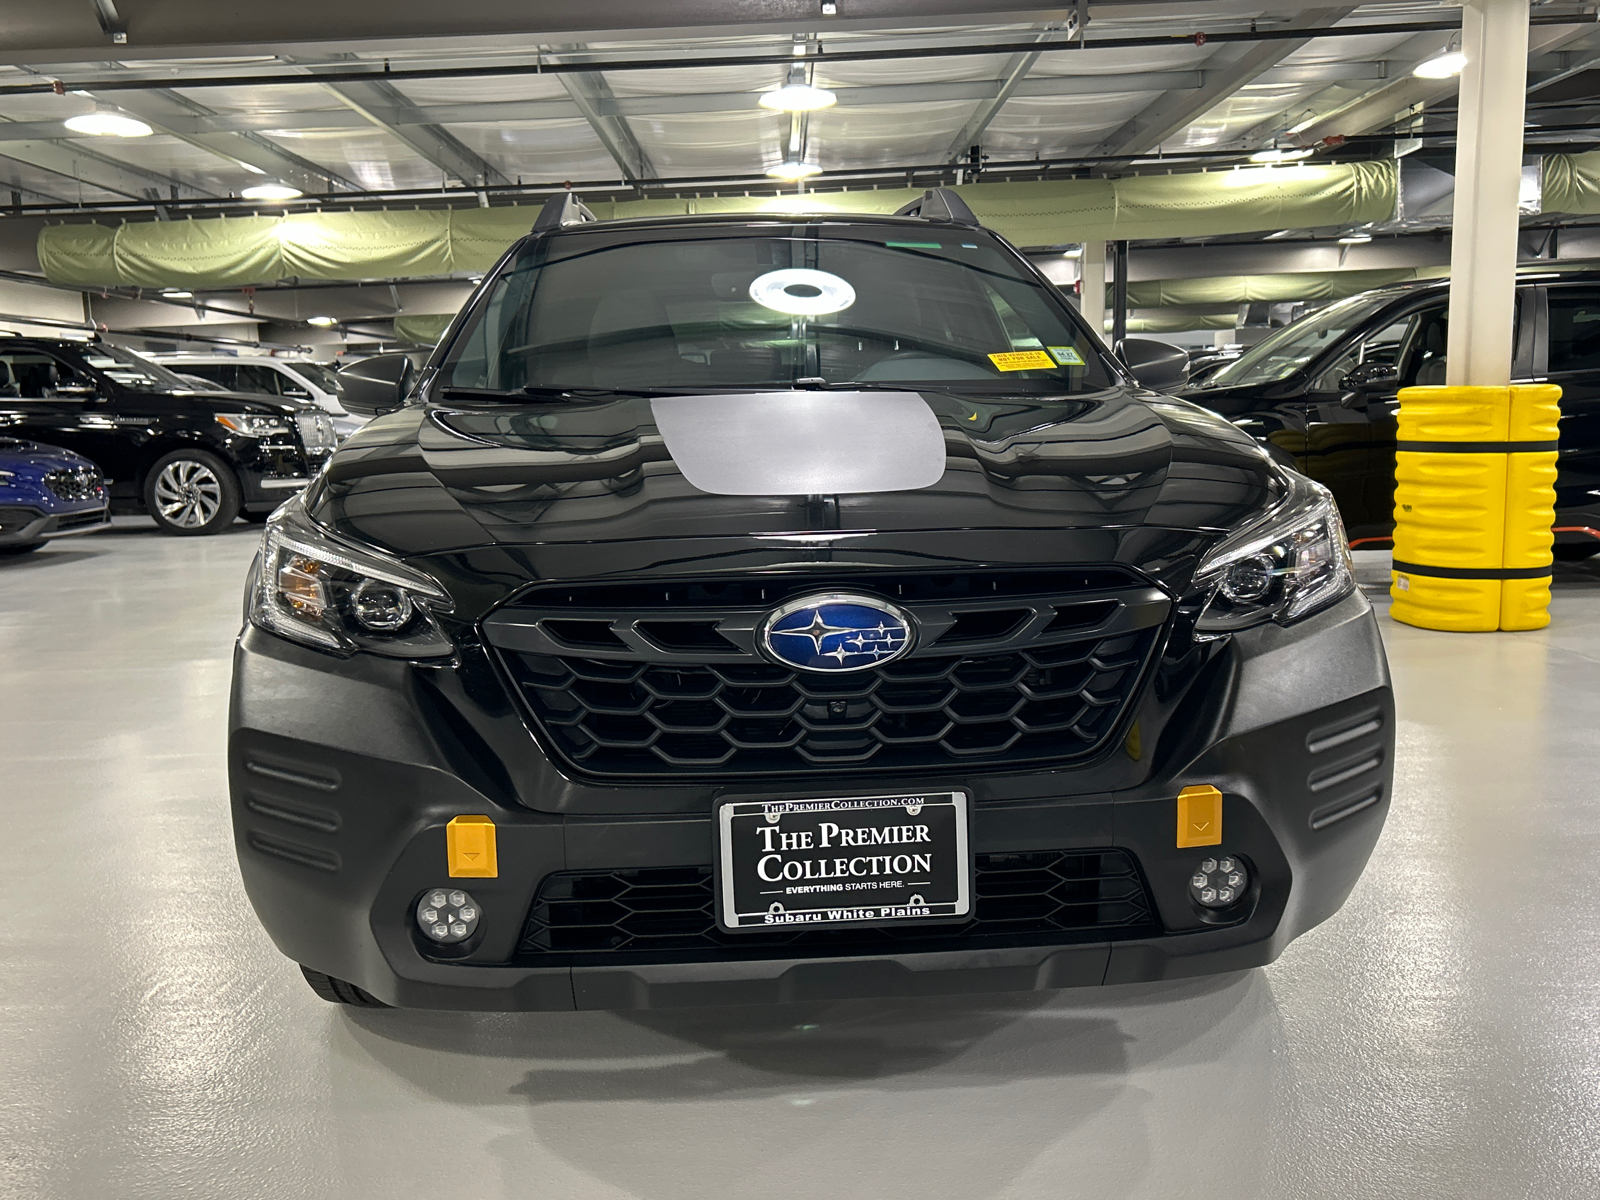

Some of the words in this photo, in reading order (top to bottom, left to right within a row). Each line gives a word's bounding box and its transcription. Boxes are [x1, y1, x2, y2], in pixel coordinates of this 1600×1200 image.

[756, 825, 814, 852] THE
[818, 822, 932, 848] PREMIER
[757, 853, 933, 882] COLLECTION
[786, 883, 844, 895] EVERYTHING
[845, 882, 878, 891] STARTS
[879, 880, 905, 889] HERE.
[764, 912, 822, 924] Subaru
[828, 909, 875, 920] White
[880, 905, 931, 917] Plains
